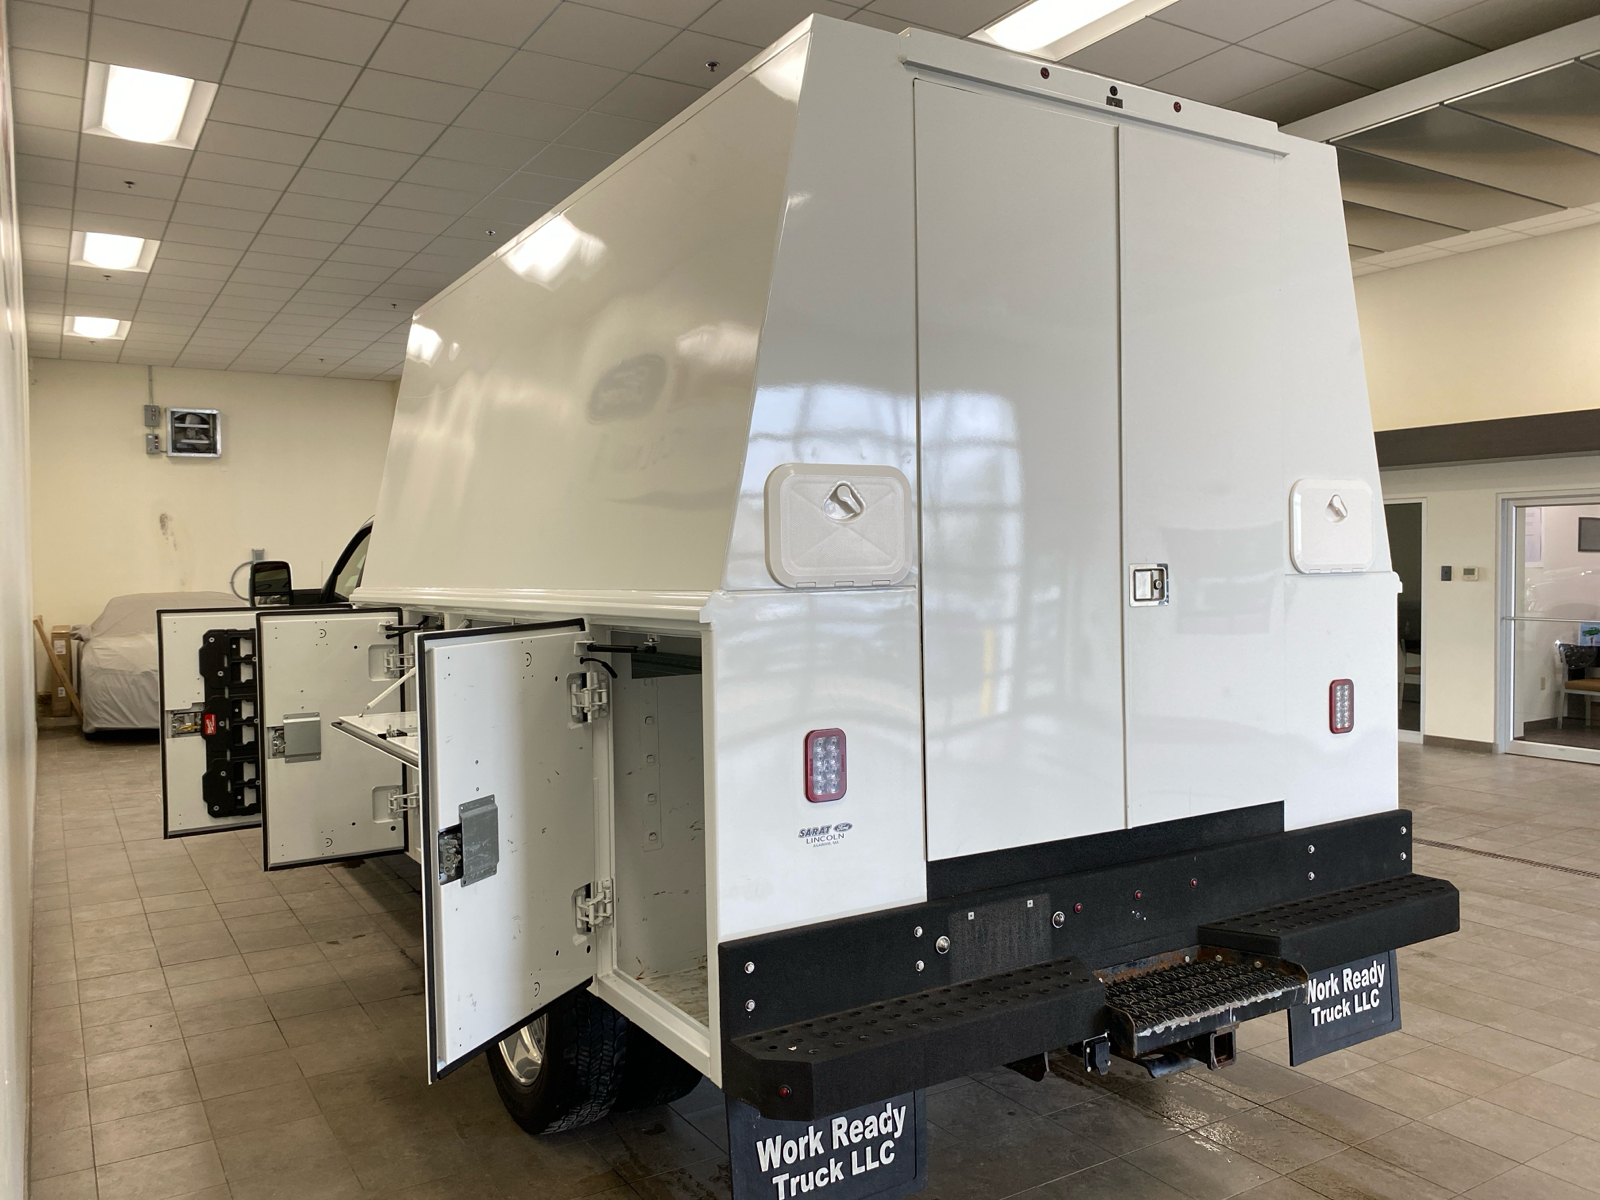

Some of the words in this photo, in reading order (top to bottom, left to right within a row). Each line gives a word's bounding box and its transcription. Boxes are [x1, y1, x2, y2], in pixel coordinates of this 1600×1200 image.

[798, 824, 832, 838] SARAT
[806, 833, 845, 844] LINCOLN
[1342, 960, 1385, 993] Ready
[1311, 998, 1351, 1027] Truck
[1354, 988, 1380, 1013] LLC
[756, 1125, 825, 1172] Work
[831, 1102, 906, 1149] Ready
[772, 1158, 844, 1200] Truck
[851, 1140, 895, 1176] LLC
